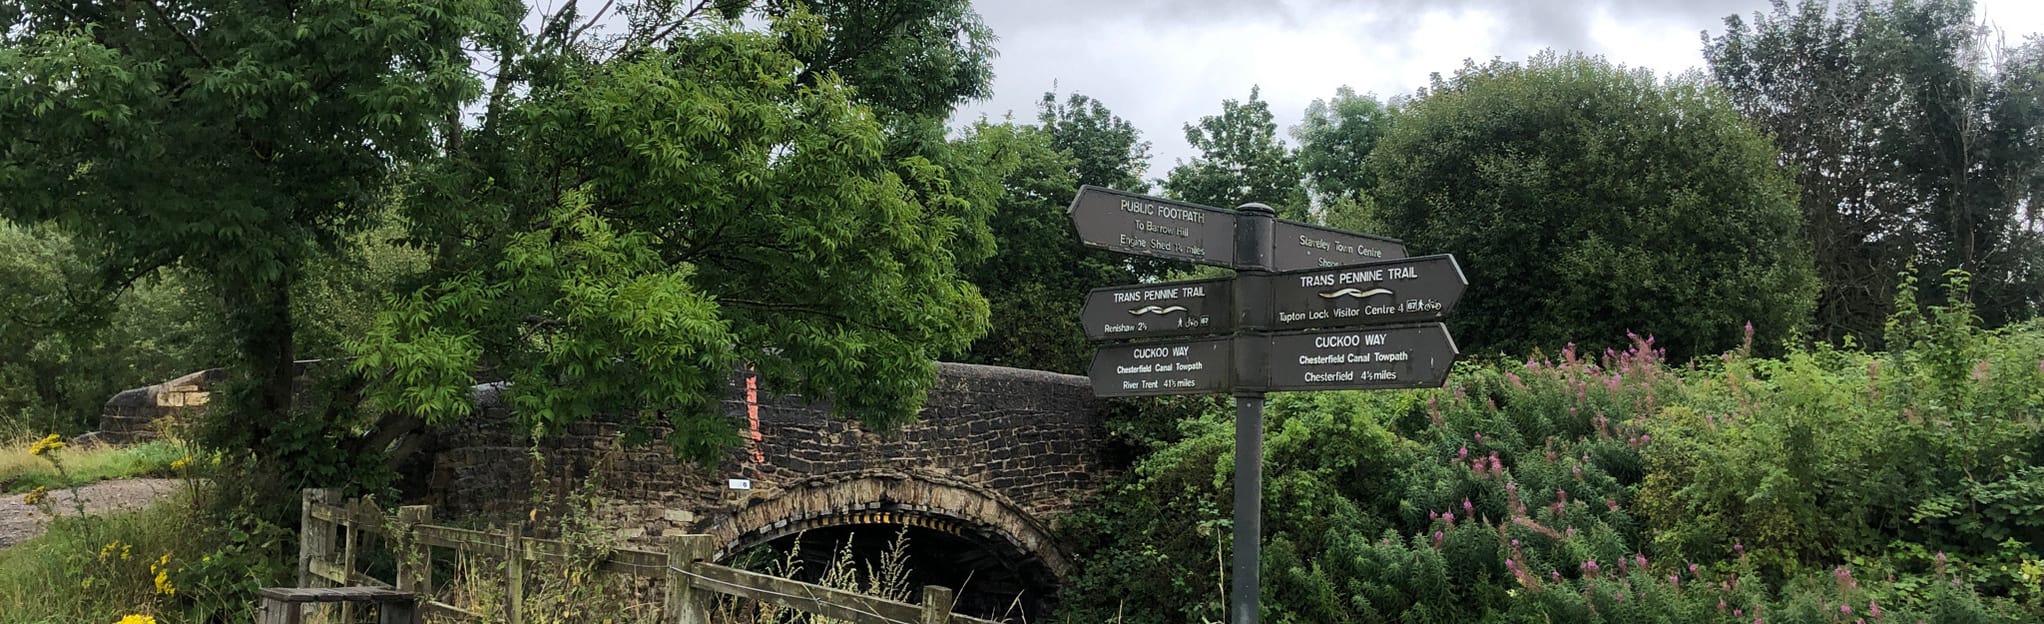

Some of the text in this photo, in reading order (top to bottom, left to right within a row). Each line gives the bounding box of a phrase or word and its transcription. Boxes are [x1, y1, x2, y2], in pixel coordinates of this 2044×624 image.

[1120, 199, 1205, 223] PUBLIC FOOTPATH
[1135, 219, 1189, 237] To Barrow Hill
[1120, 233, 1147, 247] Engine
[1151, 239, 1171, 251] Shed
[1186, 246, 1206, 256] miles
[1299, 234, 1330, 251] Staveley
[1357, 245, 1382, 258] Centre
[1300, 267, 1418, 287] TRANS PENNINE TRAIL
[1113, 286, 1206, 303] TRANS PENNINE TRAIL
[1279, 312, 1306, 323] Tapton
[1308, 310, 1329, 319] Lock
[1333, 307, 1360, 318] Visitor
[1364, 304, 1395, 316] Centre
[1104, 324, 1135, 333] Renishaw
[1315, 333, 1387, 348] CUCKOO WAY
[1133, 346, 1189, 359] CUCKOO WAY
[1299, 351, 1408, 365] Chesterfield Canal Towpath
[1116, 362, 1203, 374] Chesterfield Canal Towpath
[1304, 371, 1354, 382] Chesterfield
[1374, 369, 1397, 380] miles
[1123, 381, 1139, 390] River
[1141, 380, 1158, 389] Trent
[1177, 379, 1196, 388] miles
